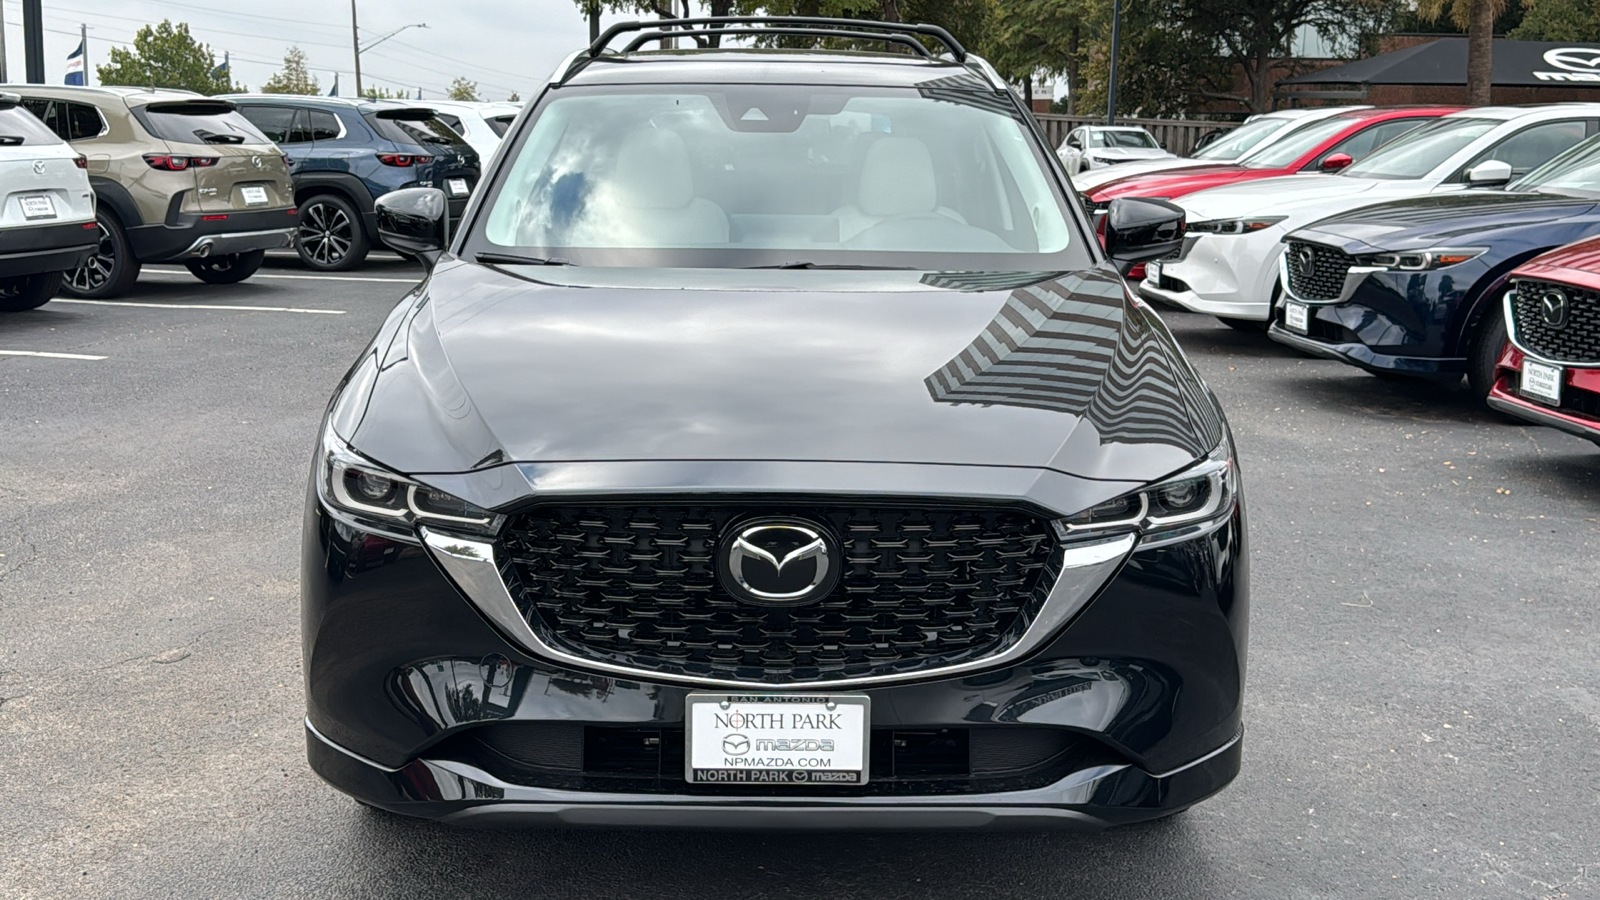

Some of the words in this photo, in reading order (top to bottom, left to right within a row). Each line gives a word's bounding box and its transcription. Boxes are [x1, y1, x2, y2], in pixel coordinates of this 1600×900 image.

[714, 712, 784, 729] NORTH
[792, 713, 842, 729] PARK
[755, 739, 834, 751] mazda
[724, 757, 831, 767] NPMAZDA.COM
[697, 770, 746, 781] NORTH
[751, 771, 789, 782] PARK
[811, 772, 857, 781] mazda
